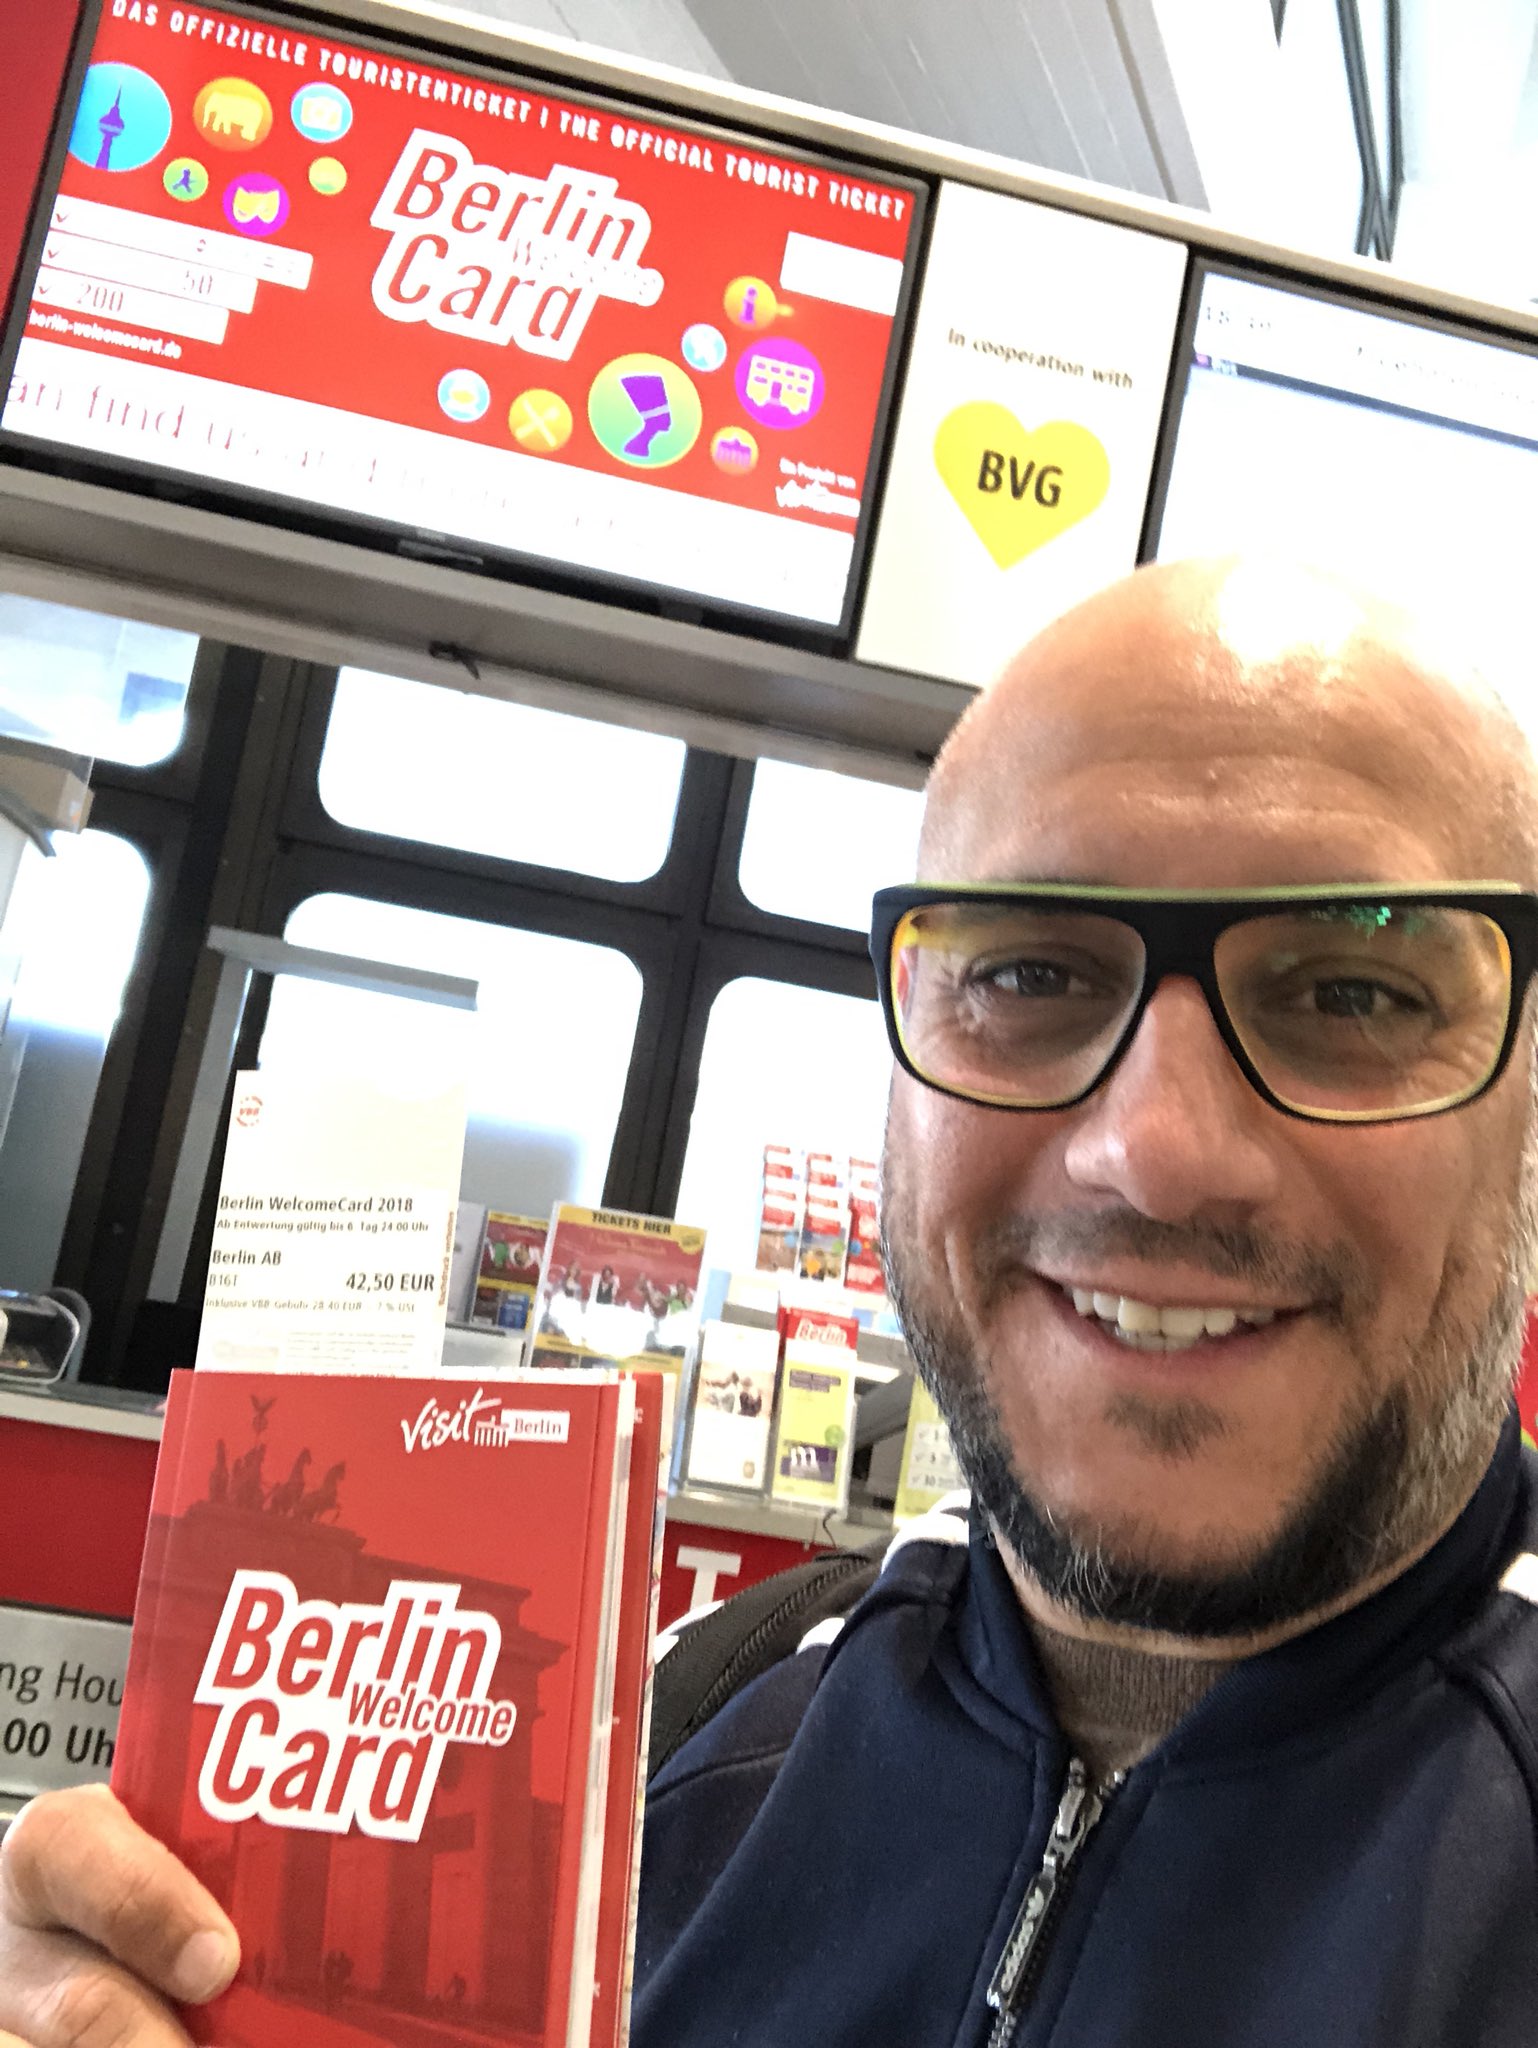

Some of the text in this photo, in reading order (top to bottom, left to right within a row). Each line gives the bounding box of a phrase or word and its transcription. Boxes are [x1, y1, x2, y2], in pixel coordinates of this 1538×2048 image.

[112, 0, 158, 27] DAS
[169, 10, 308, 66] OFFIZIELLE
[319, 48, 532, 123] TOURISTENTICKET
[560, 110, 601, 142] THE
[610, 124, 714, 173] OFFICIAL
[725, 153, 820, 199] TOURIST
[829, 180, 906, 222] TICKET
[393, 148, 636, 262] Berlin
[76, 282, 124, 311] 200
[387, 233, 583, 342] Card
[948, 328, 1133, 390] In cooperation with
[87, 385, 185, 439] find
[977, 449, 1064, 509] BVG
[216, 1218, 231, 1230] Ab
[233, 1220, 294, 1233] Entwertung
[296, 1221, 327, 1234] gültig
[329, 1221, 344, 1232] bis
[360, 1221, 378, 1233] Tag
[411, 1221, 430, 1232] Uhr
[219, 1195, 414, 1213] Berlin WelcomeCard 2018
[592, 1211, 672, 1235] TICKETS HIER
[212, 1249, 282, 1266] Berlin AB
[346, 1273, 435, 1293] 42,50 EUR
[401, 1386, 562, 1454] Visit Berlin
[213, 1587, 488, 1699] Berlin
[3, 1717, 51, 1758] 00
[348, 1681, 513, 1740] Welcome
[212, 1698, 433, 1823] Card
